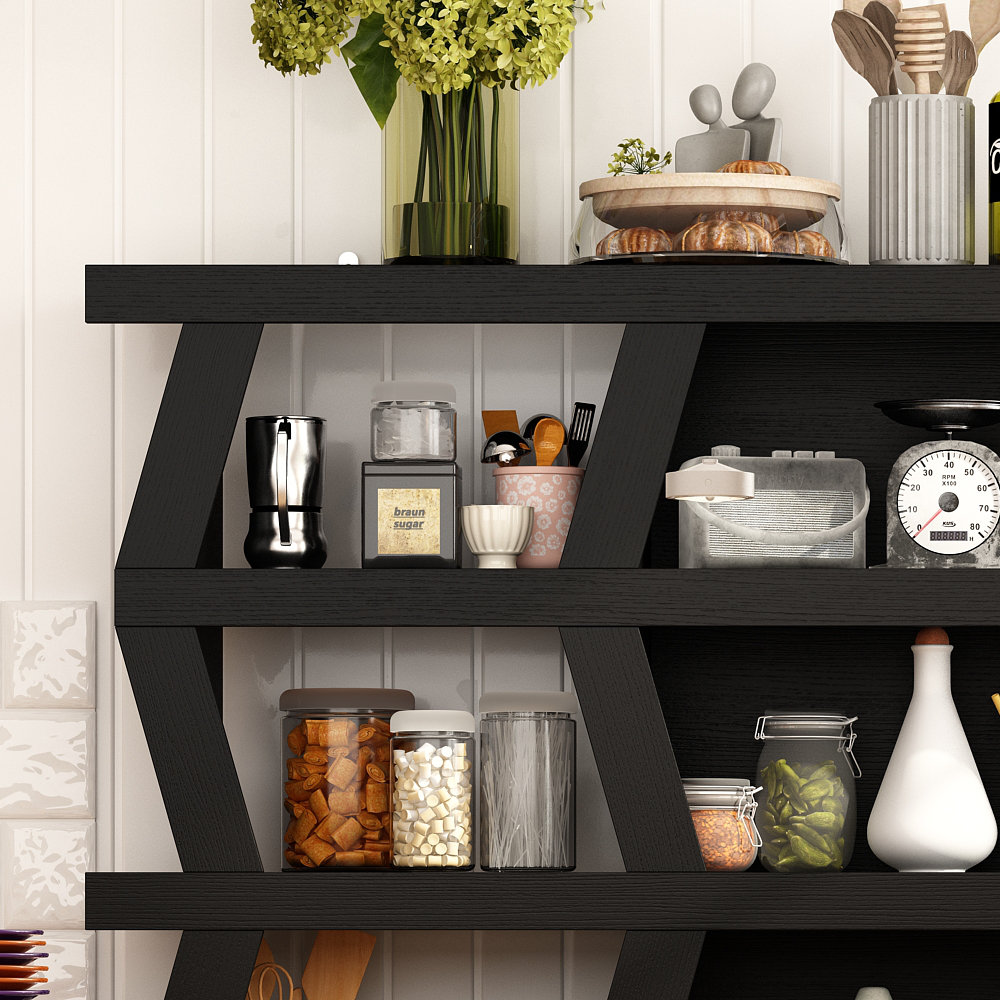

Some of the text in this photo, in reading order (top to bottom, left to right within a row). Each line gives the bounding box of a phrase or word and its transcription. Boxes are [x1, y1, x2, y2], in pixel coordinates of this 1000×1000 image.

[964, 468, 974, 476] 50
[394, 506, 425, 517] braun
[394, 521, 424, 530] sugar
